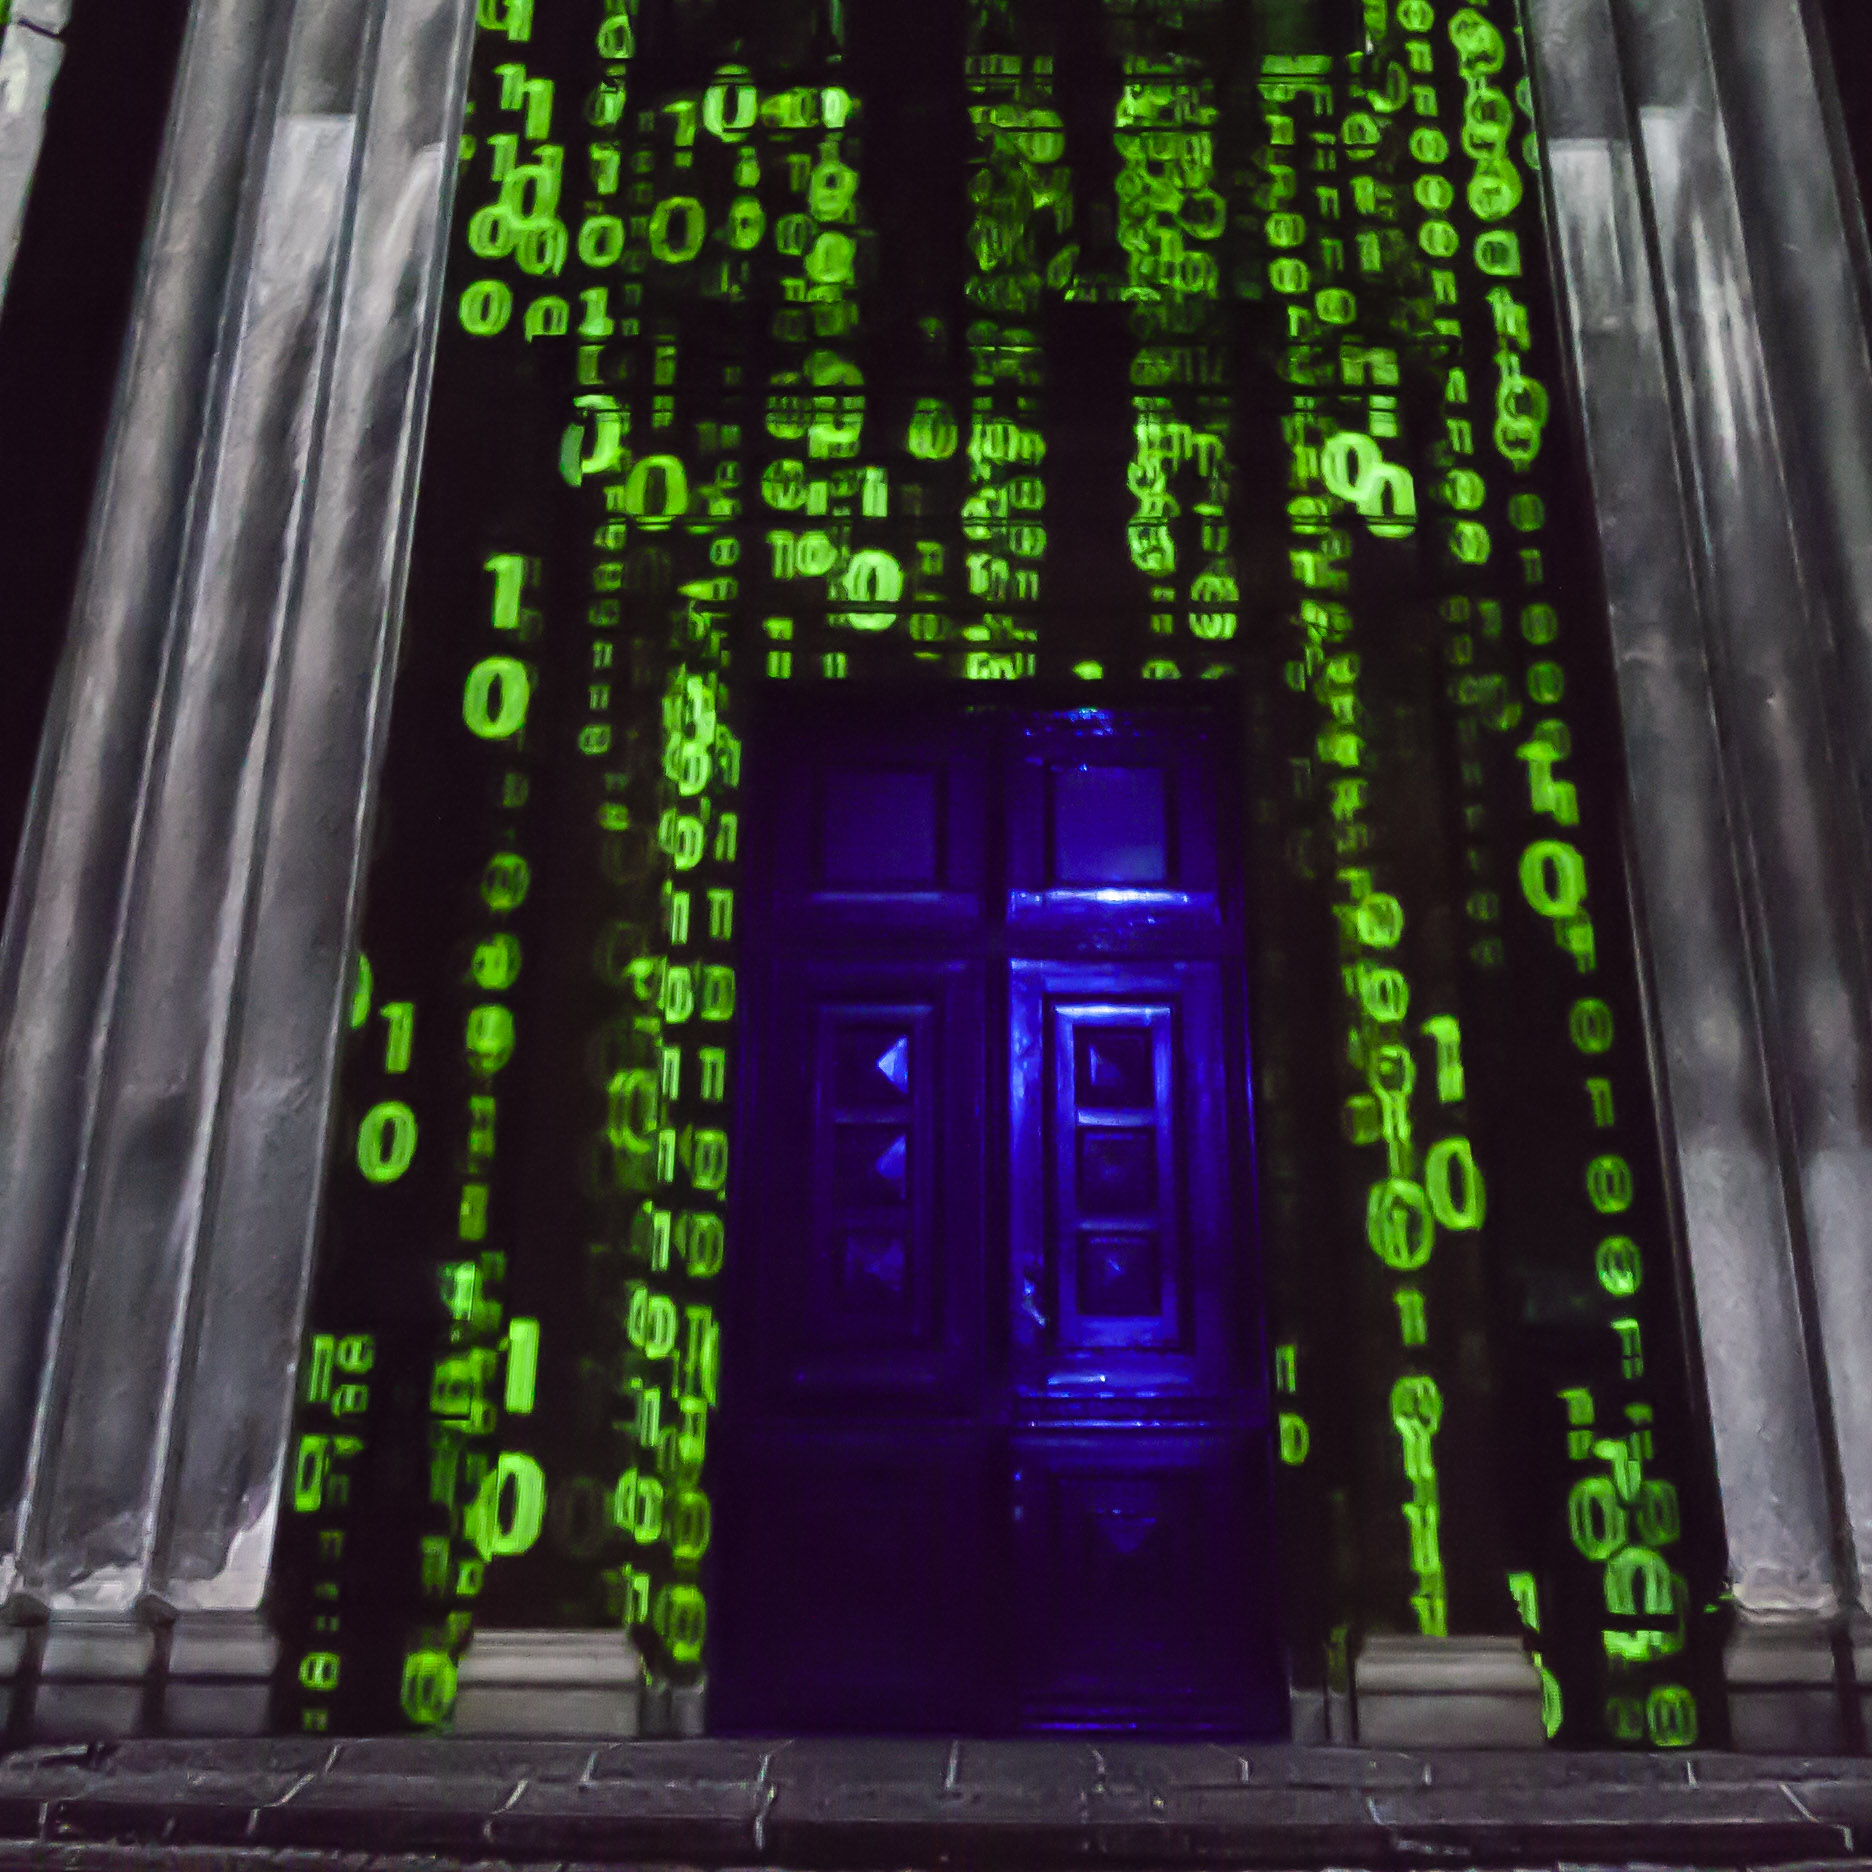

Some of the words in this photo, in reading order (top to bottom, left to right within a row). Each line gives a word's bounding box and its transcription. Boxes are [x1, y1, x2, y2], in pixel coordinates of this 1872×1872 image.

[494, 63, 525, 110] 1
[523, 78, 554, 140] 1
[486, 133, 518, 182] 1
[484, 553, 526, 630] 1
[381, 1002, 414, 1073] 1
[1422, 1014, 1464, 1102] 1
[498, 1317, 540, 1415] 1
